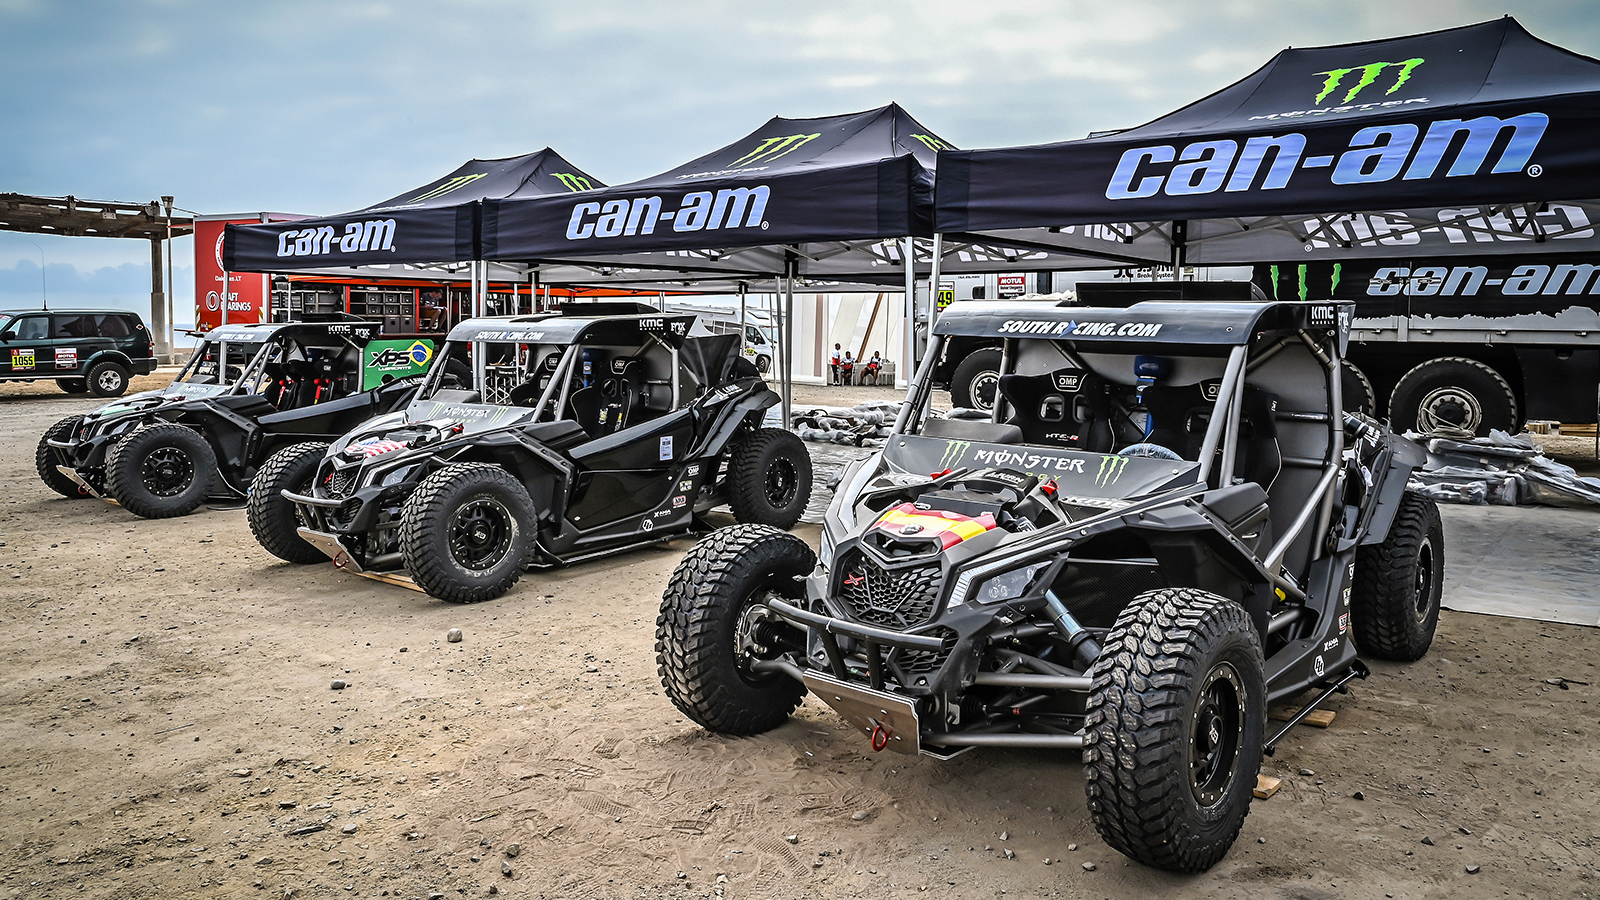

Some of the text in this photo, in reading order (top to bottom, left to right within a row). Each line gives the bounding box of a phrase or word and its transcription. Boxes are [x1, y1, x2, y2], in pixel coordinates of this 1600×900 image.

[1105, 112, 1549, 200] can-am
[566, 185, 770, 240] can-am
[277, 218, 396, 257] can-am
[1311, 306, 1334, 319] KMC
[639, 319, 663, 327] KMC
[14, 356, 33, 365] 1055
[366, 348, 412, 367] XPS
[1058, 378, 1078, 386] OMP
[974, 450, 1086, 474] MONSTER
